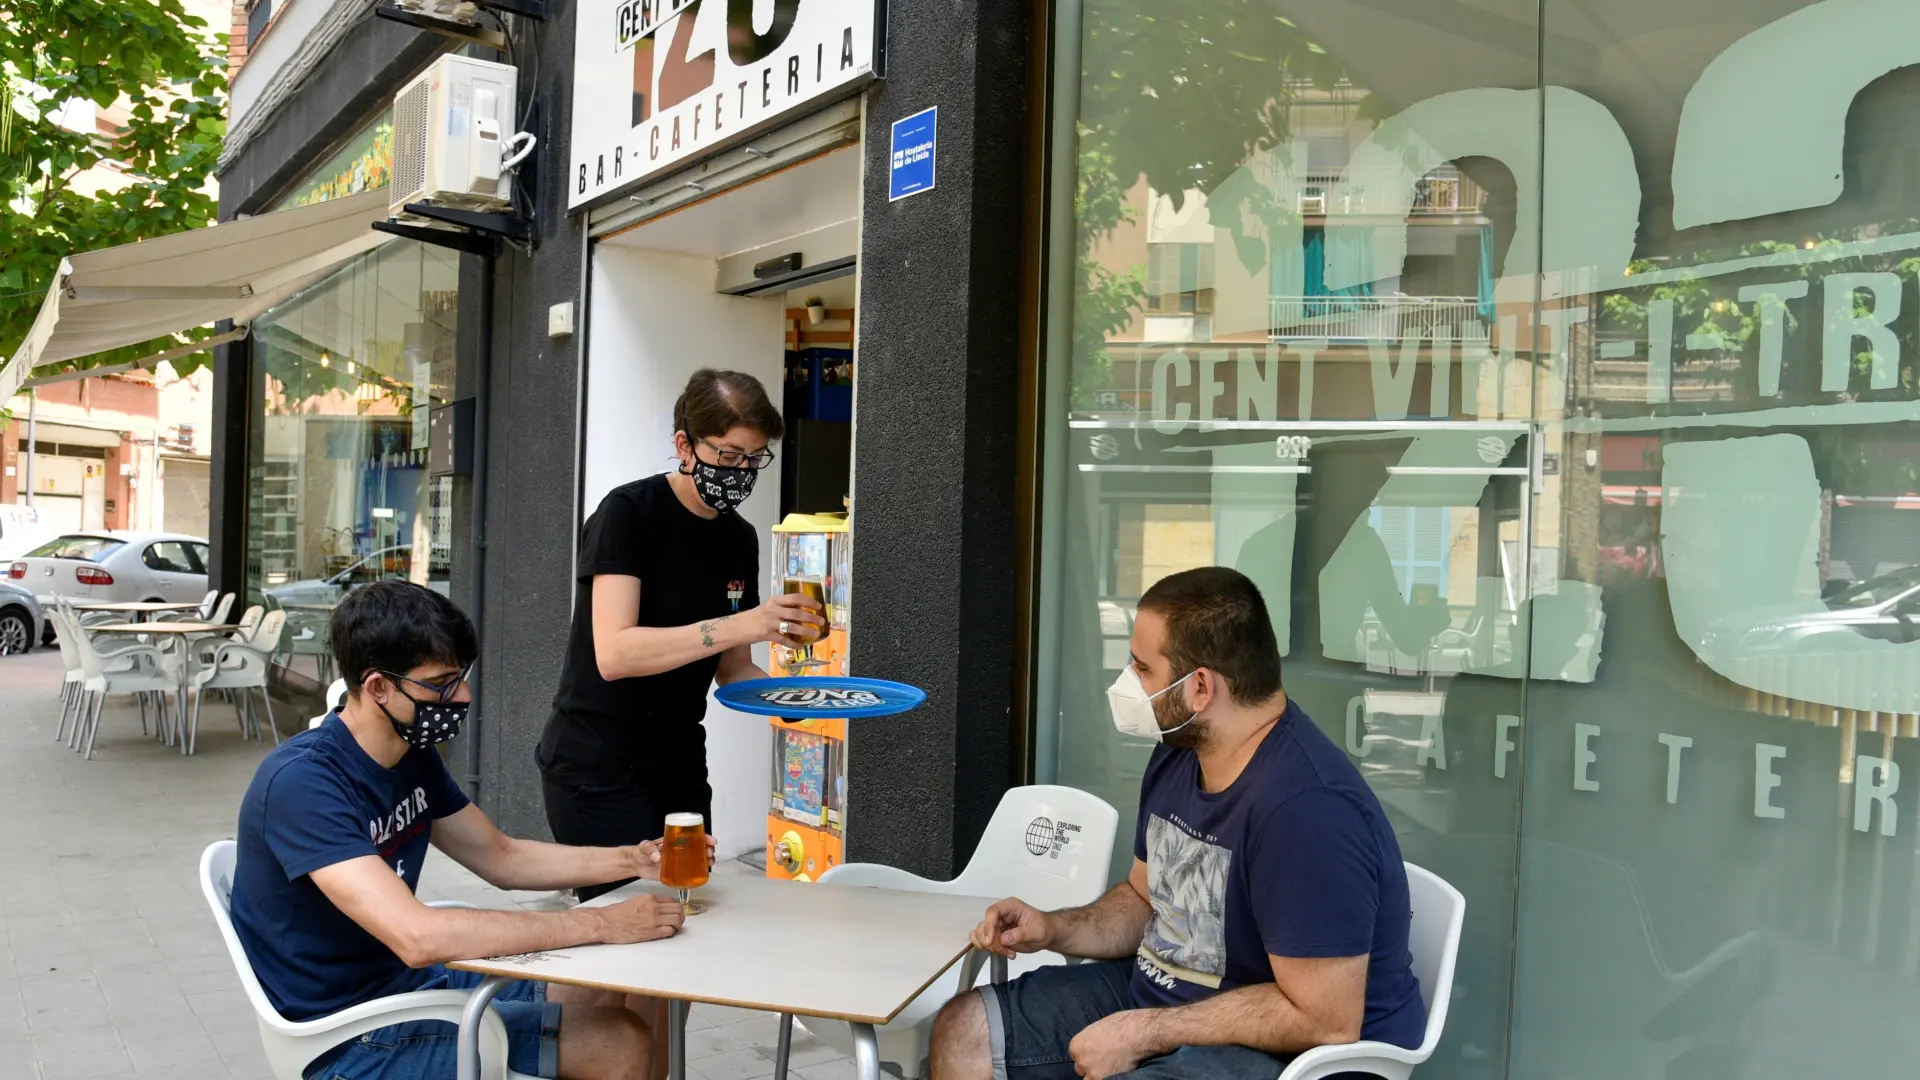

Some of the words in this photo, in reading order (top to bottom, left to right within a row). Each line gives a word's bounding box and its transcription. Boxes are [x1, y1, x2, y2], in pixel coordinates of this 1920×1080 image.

[904, 156, 912, 166] de
[912, 151, 930, 163] Lleida
[1151, 339, 1328, 436] CENT
[1367, 270, 1920, 421] VINT-I-TR
[1055, 828, 1065, 836] THE
[1056, 821, 1081, 832] EXPLORING
[1054, 835, 1070, 844] WORLD
